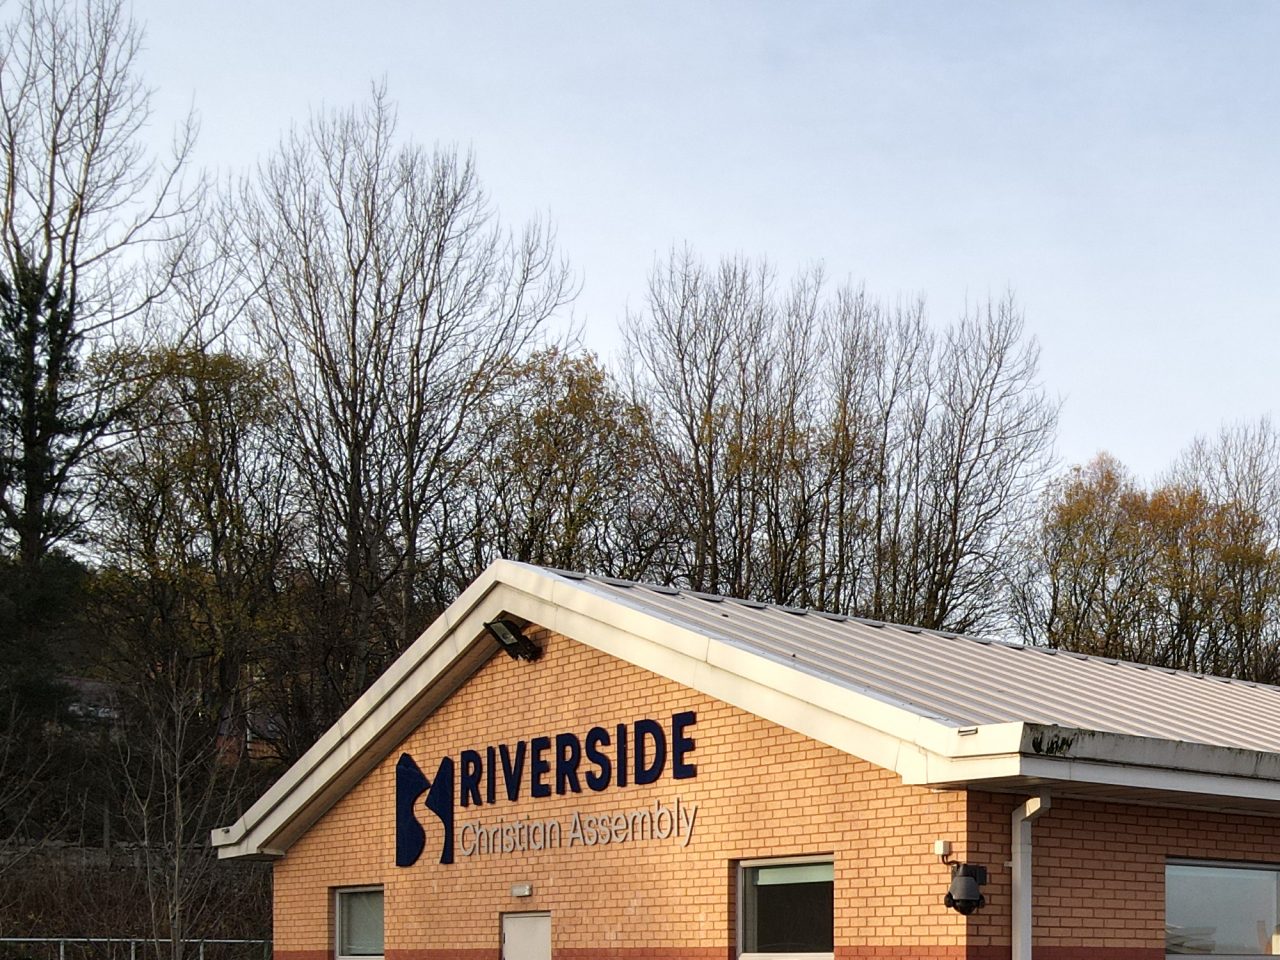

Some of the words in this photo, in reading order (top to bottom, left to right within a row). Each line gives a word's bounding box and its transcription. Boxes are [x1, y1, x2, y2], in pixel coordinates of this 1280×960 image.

[460, 710, 698, 807] RIVERSIDE
[459, 814, 562, 857] Christian
[568, 796, 699, 848] Assembly
